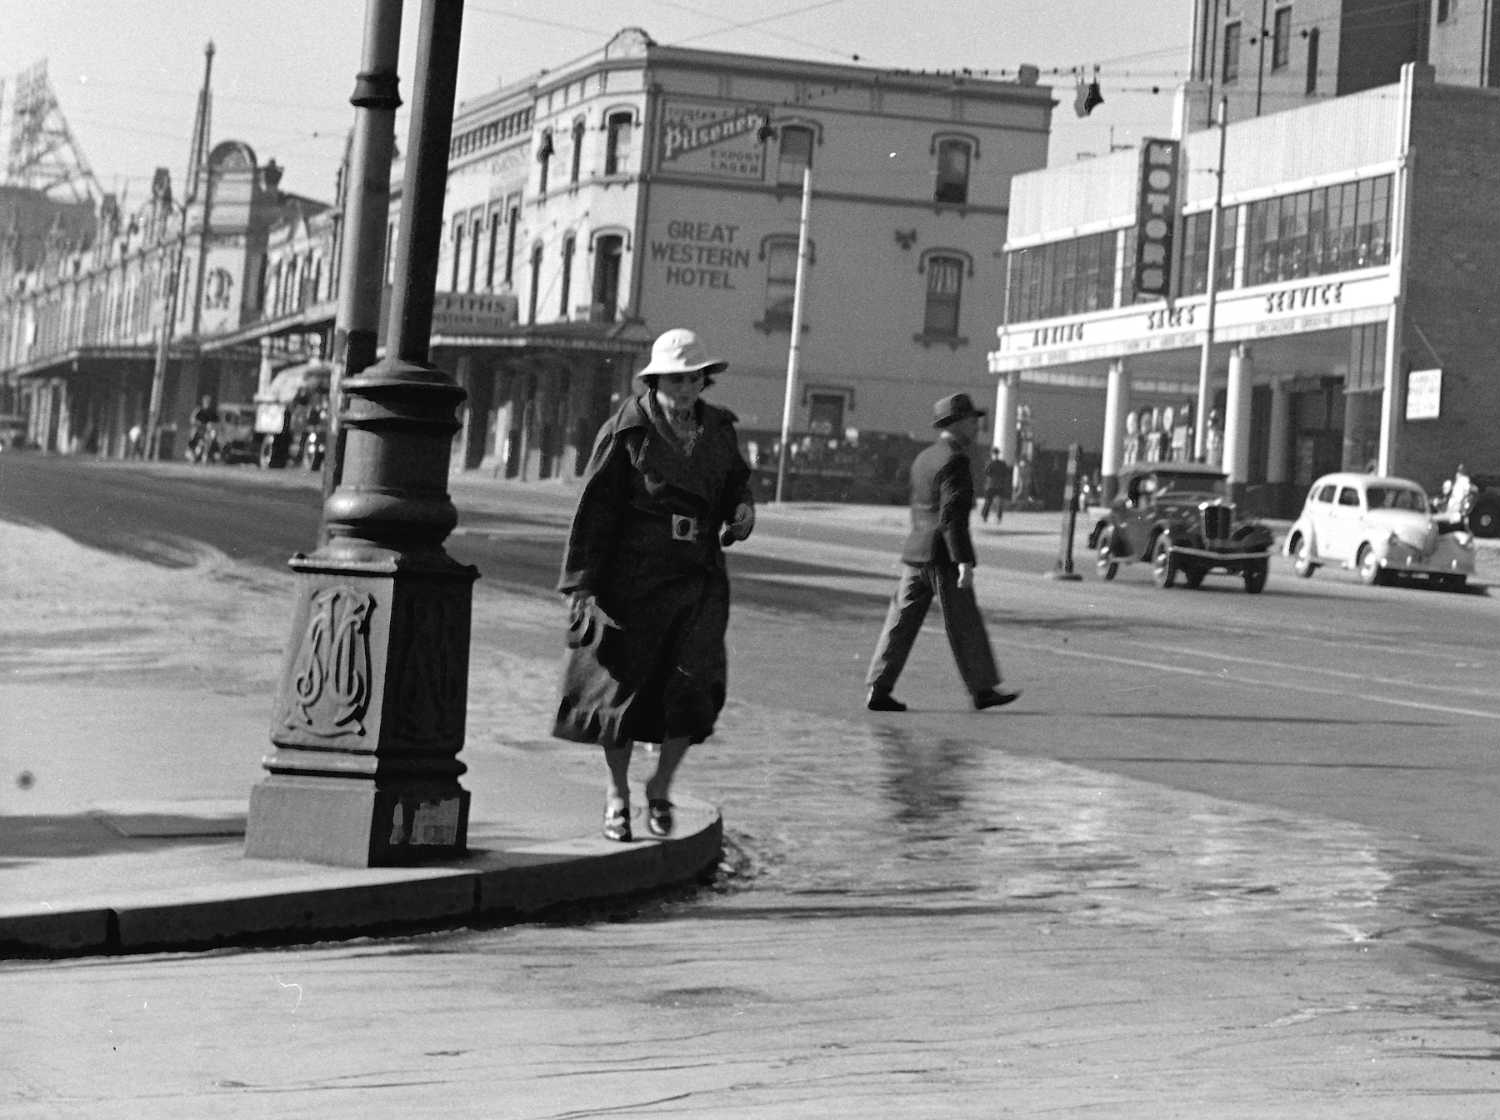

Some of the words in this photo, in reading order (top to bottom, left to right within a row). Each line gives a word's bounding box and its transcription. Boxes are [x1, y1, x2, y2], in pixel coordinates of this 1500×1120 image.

[667, 221, 740, 243] GREAT
[651, 241, 750, 268] WESTERN
[666, 266, 736, 289] HOTEL
[1147, 304, 1196, 330] SALES
[1266, 282, 1344, 313] SERVICE
